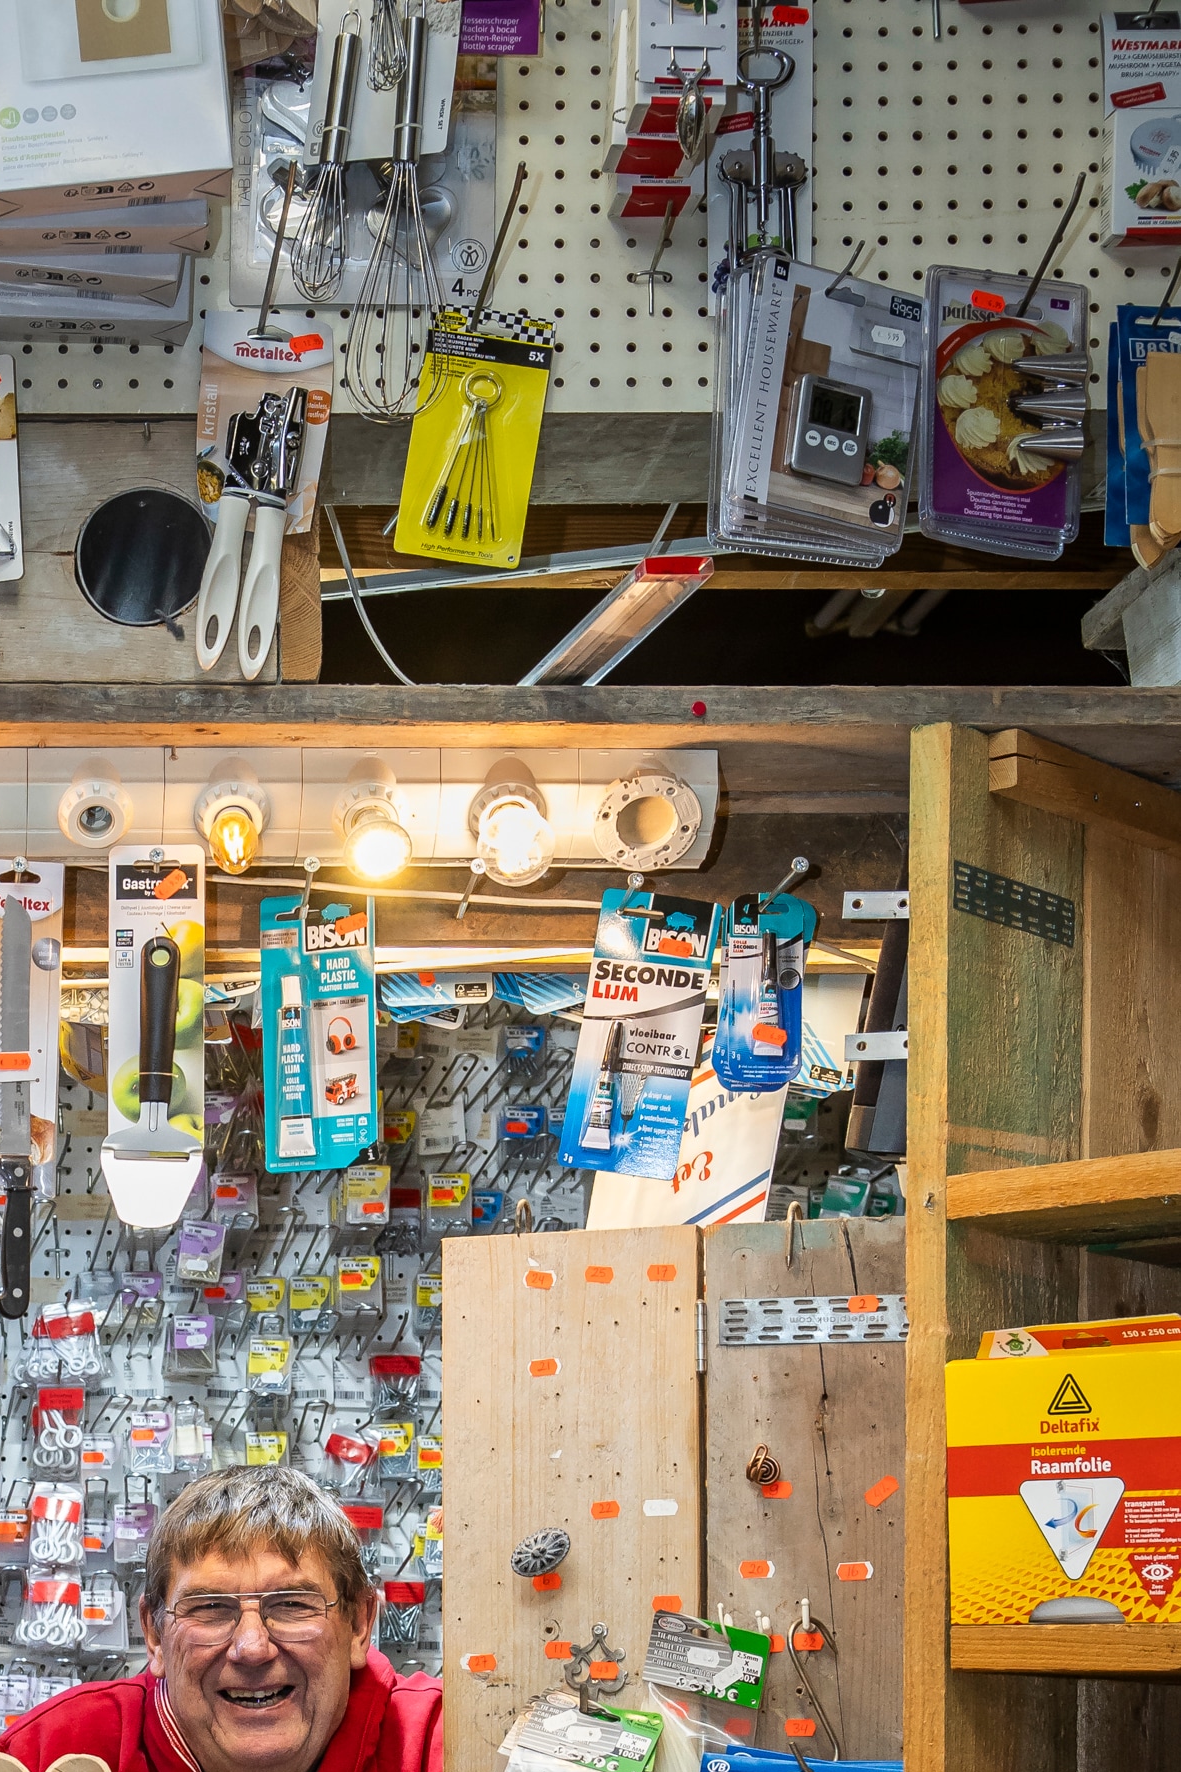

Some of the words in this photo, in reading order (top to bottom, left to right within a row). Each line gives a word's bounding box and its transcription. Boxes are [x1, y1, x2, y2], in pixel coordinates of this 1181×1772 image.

[461, 24, 488, 34] Racloir
[496, 25, 517, 34] bocal
[462, 42, 485, 51] Bottle
[486, 43, 516, 53] scraper
[239, 87, 254, 148] CLOTH
[239, 154, 253, 210] TABLE
[451, 277, 465, 298] 4
[942, 303, 996, 323] patisse
[232, 341, 303, 363] metaltex
[200, 383, 219, 437] kristall
[744, 397, 768, 493] EXCELLENT
[420, 541, 436, 552] High
[436, 543, 477, 559] Performance
[477, 547, 495, 560] Tools
[306, 923, 366, 949] BISON
[647, 928, 707, 957] BISON
[326, 958, 350, 970] HARD
[320, 970, 356, 984] PLASTIC
[594, 960, 705, 991] SECONDE
[319, 981, 343, 992] PLASTIQUE
[343, 981, 360, 990] RIGIDE
[592, 980, 639, 1002] LIJM
[629, 1028, 677, 1042] vloeibaar
[622, 1062, 689, 1078] DIRECT-STOP-TECHNOLOGY
[1121, 1329, 1139, 1339] 150
[1147, 1328, 1165, 1337] 250
[1165, 1326, 1181, 1336] cm
[1040, 1418, 1100, 1435] Deltafix
[1030, 1446, 1087, 1457] Isolerende
[1030, 1458, 1112, 1475] Raamfolie
[1124, 1500, 1166, 1509] transparant
